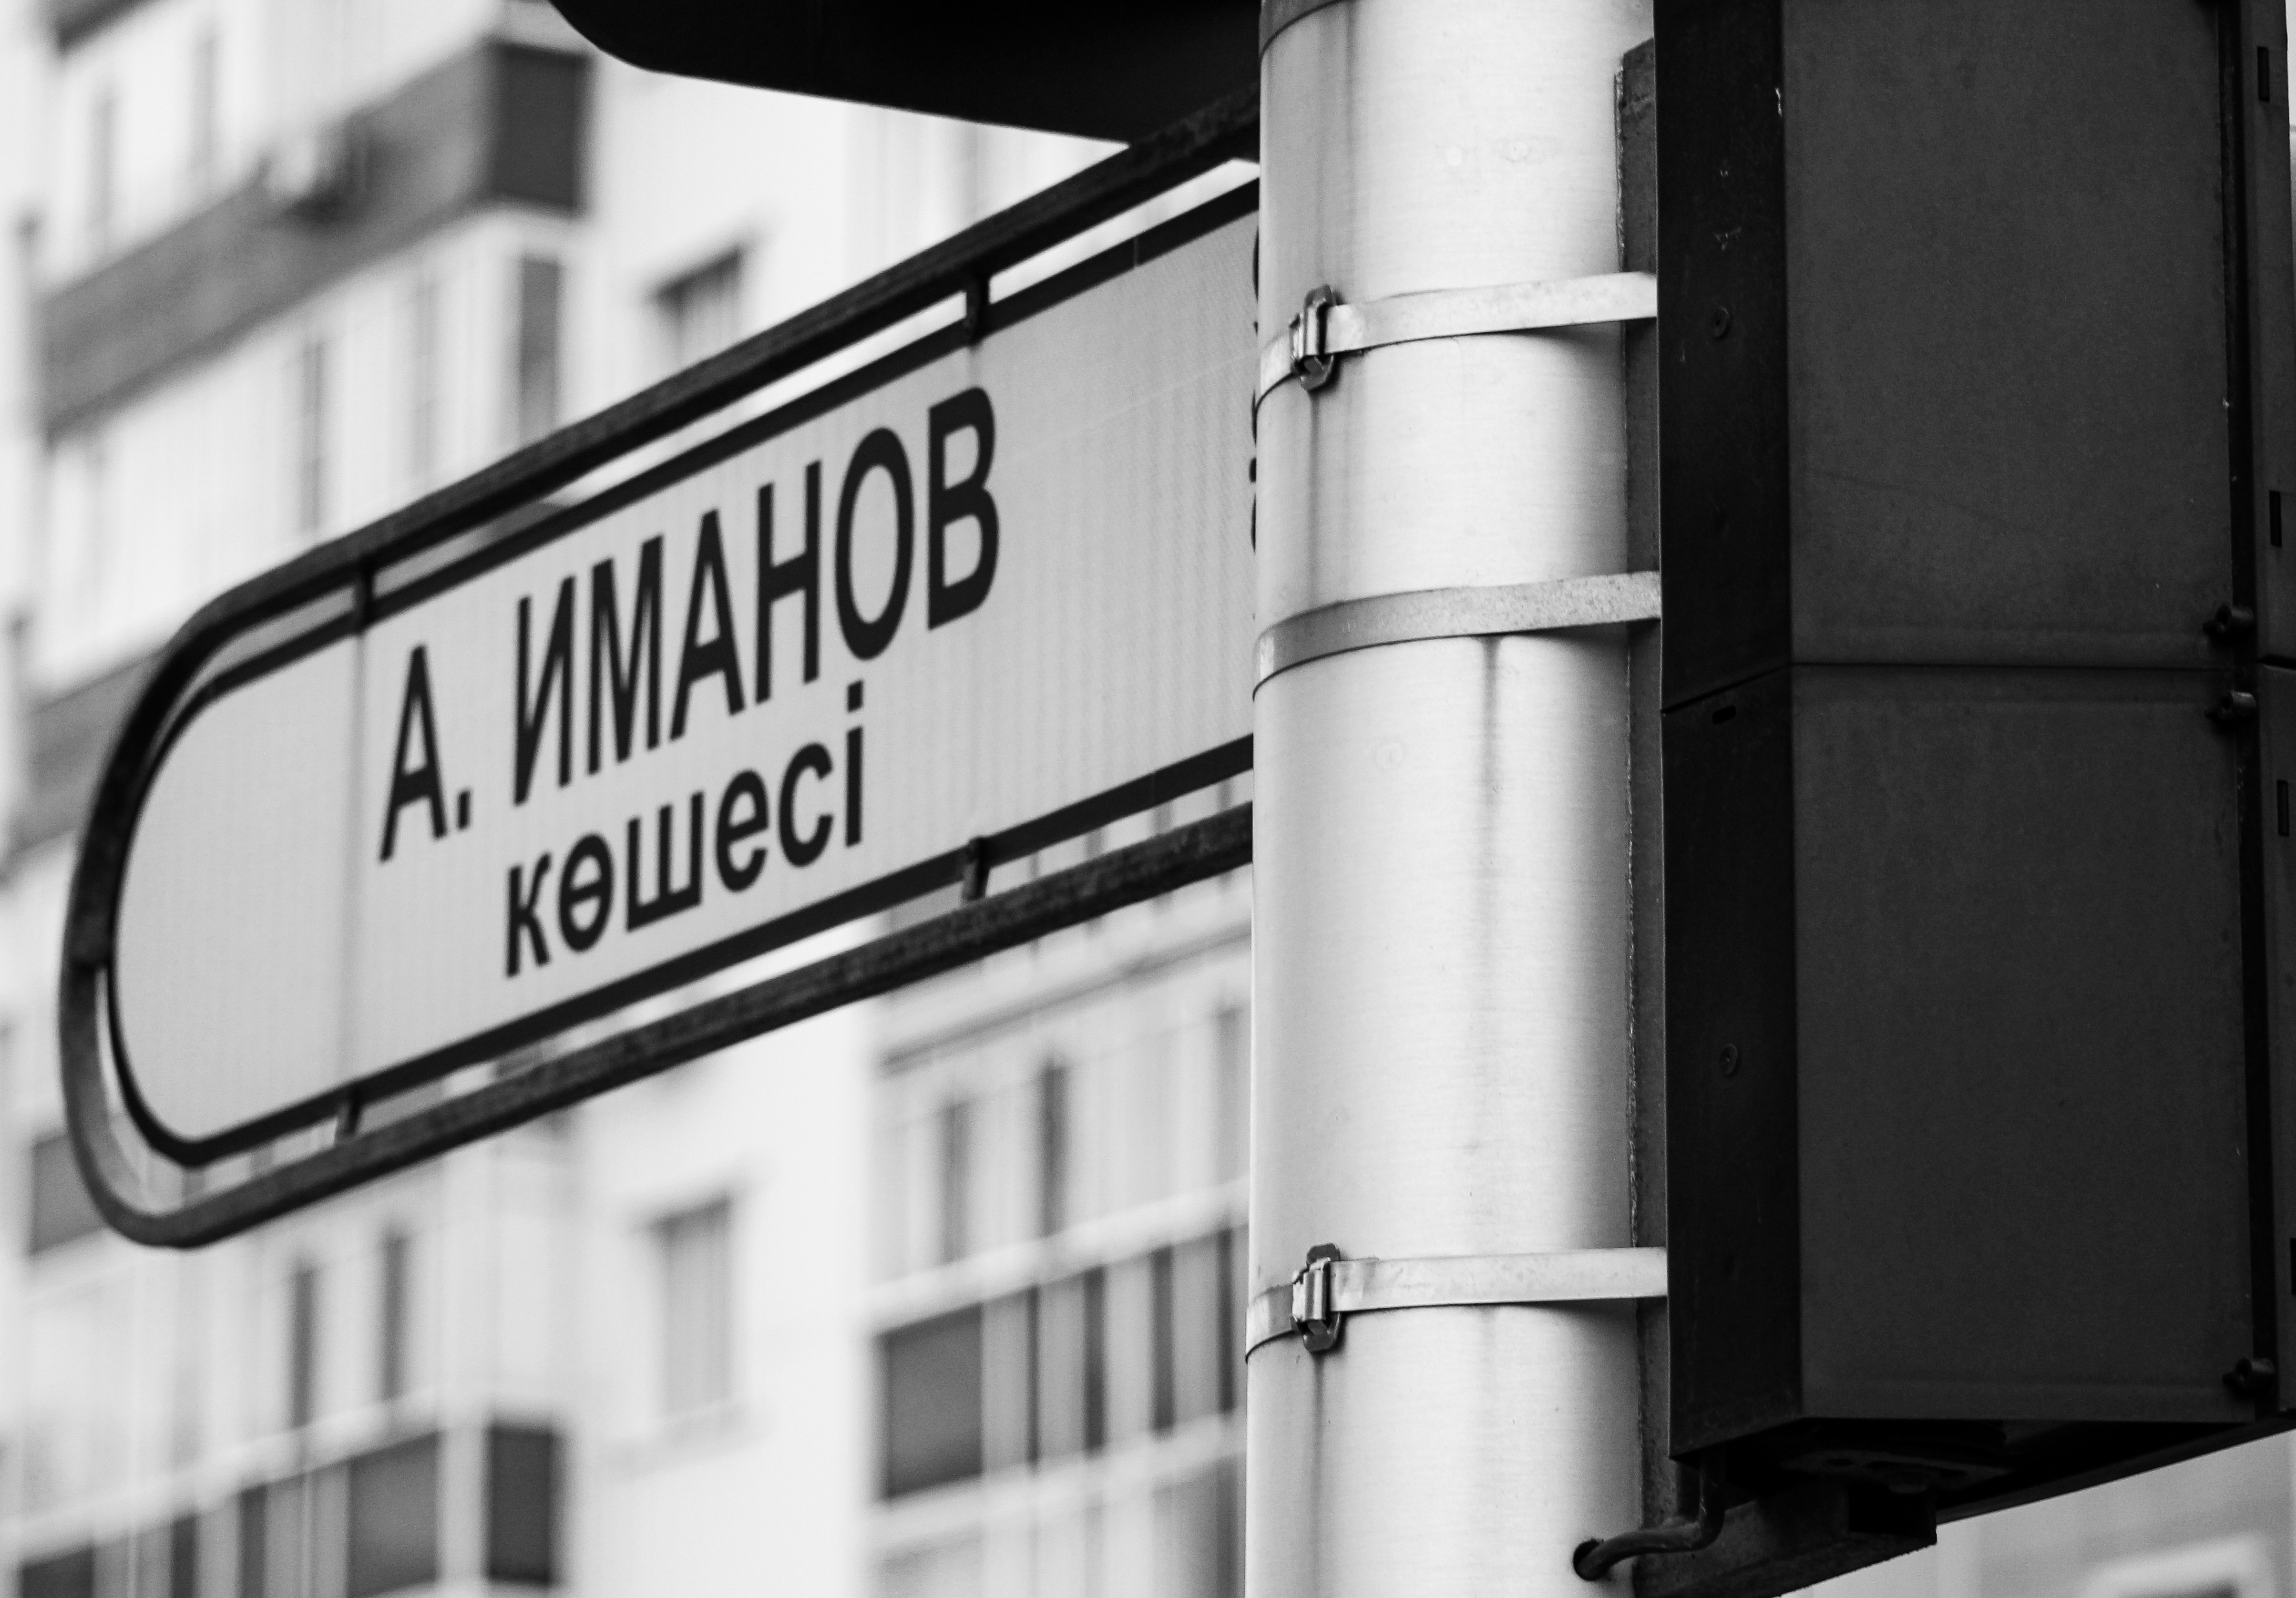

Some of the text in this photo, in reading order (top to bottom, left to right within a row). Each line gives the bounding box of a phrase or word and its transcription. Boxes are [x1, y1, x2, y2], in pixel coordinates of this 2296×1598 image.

[379, 645, 471, 862] А.
[513, 385, 1000, 807] ИМАНОВ
[505, 680, 864, 978] көшесі
